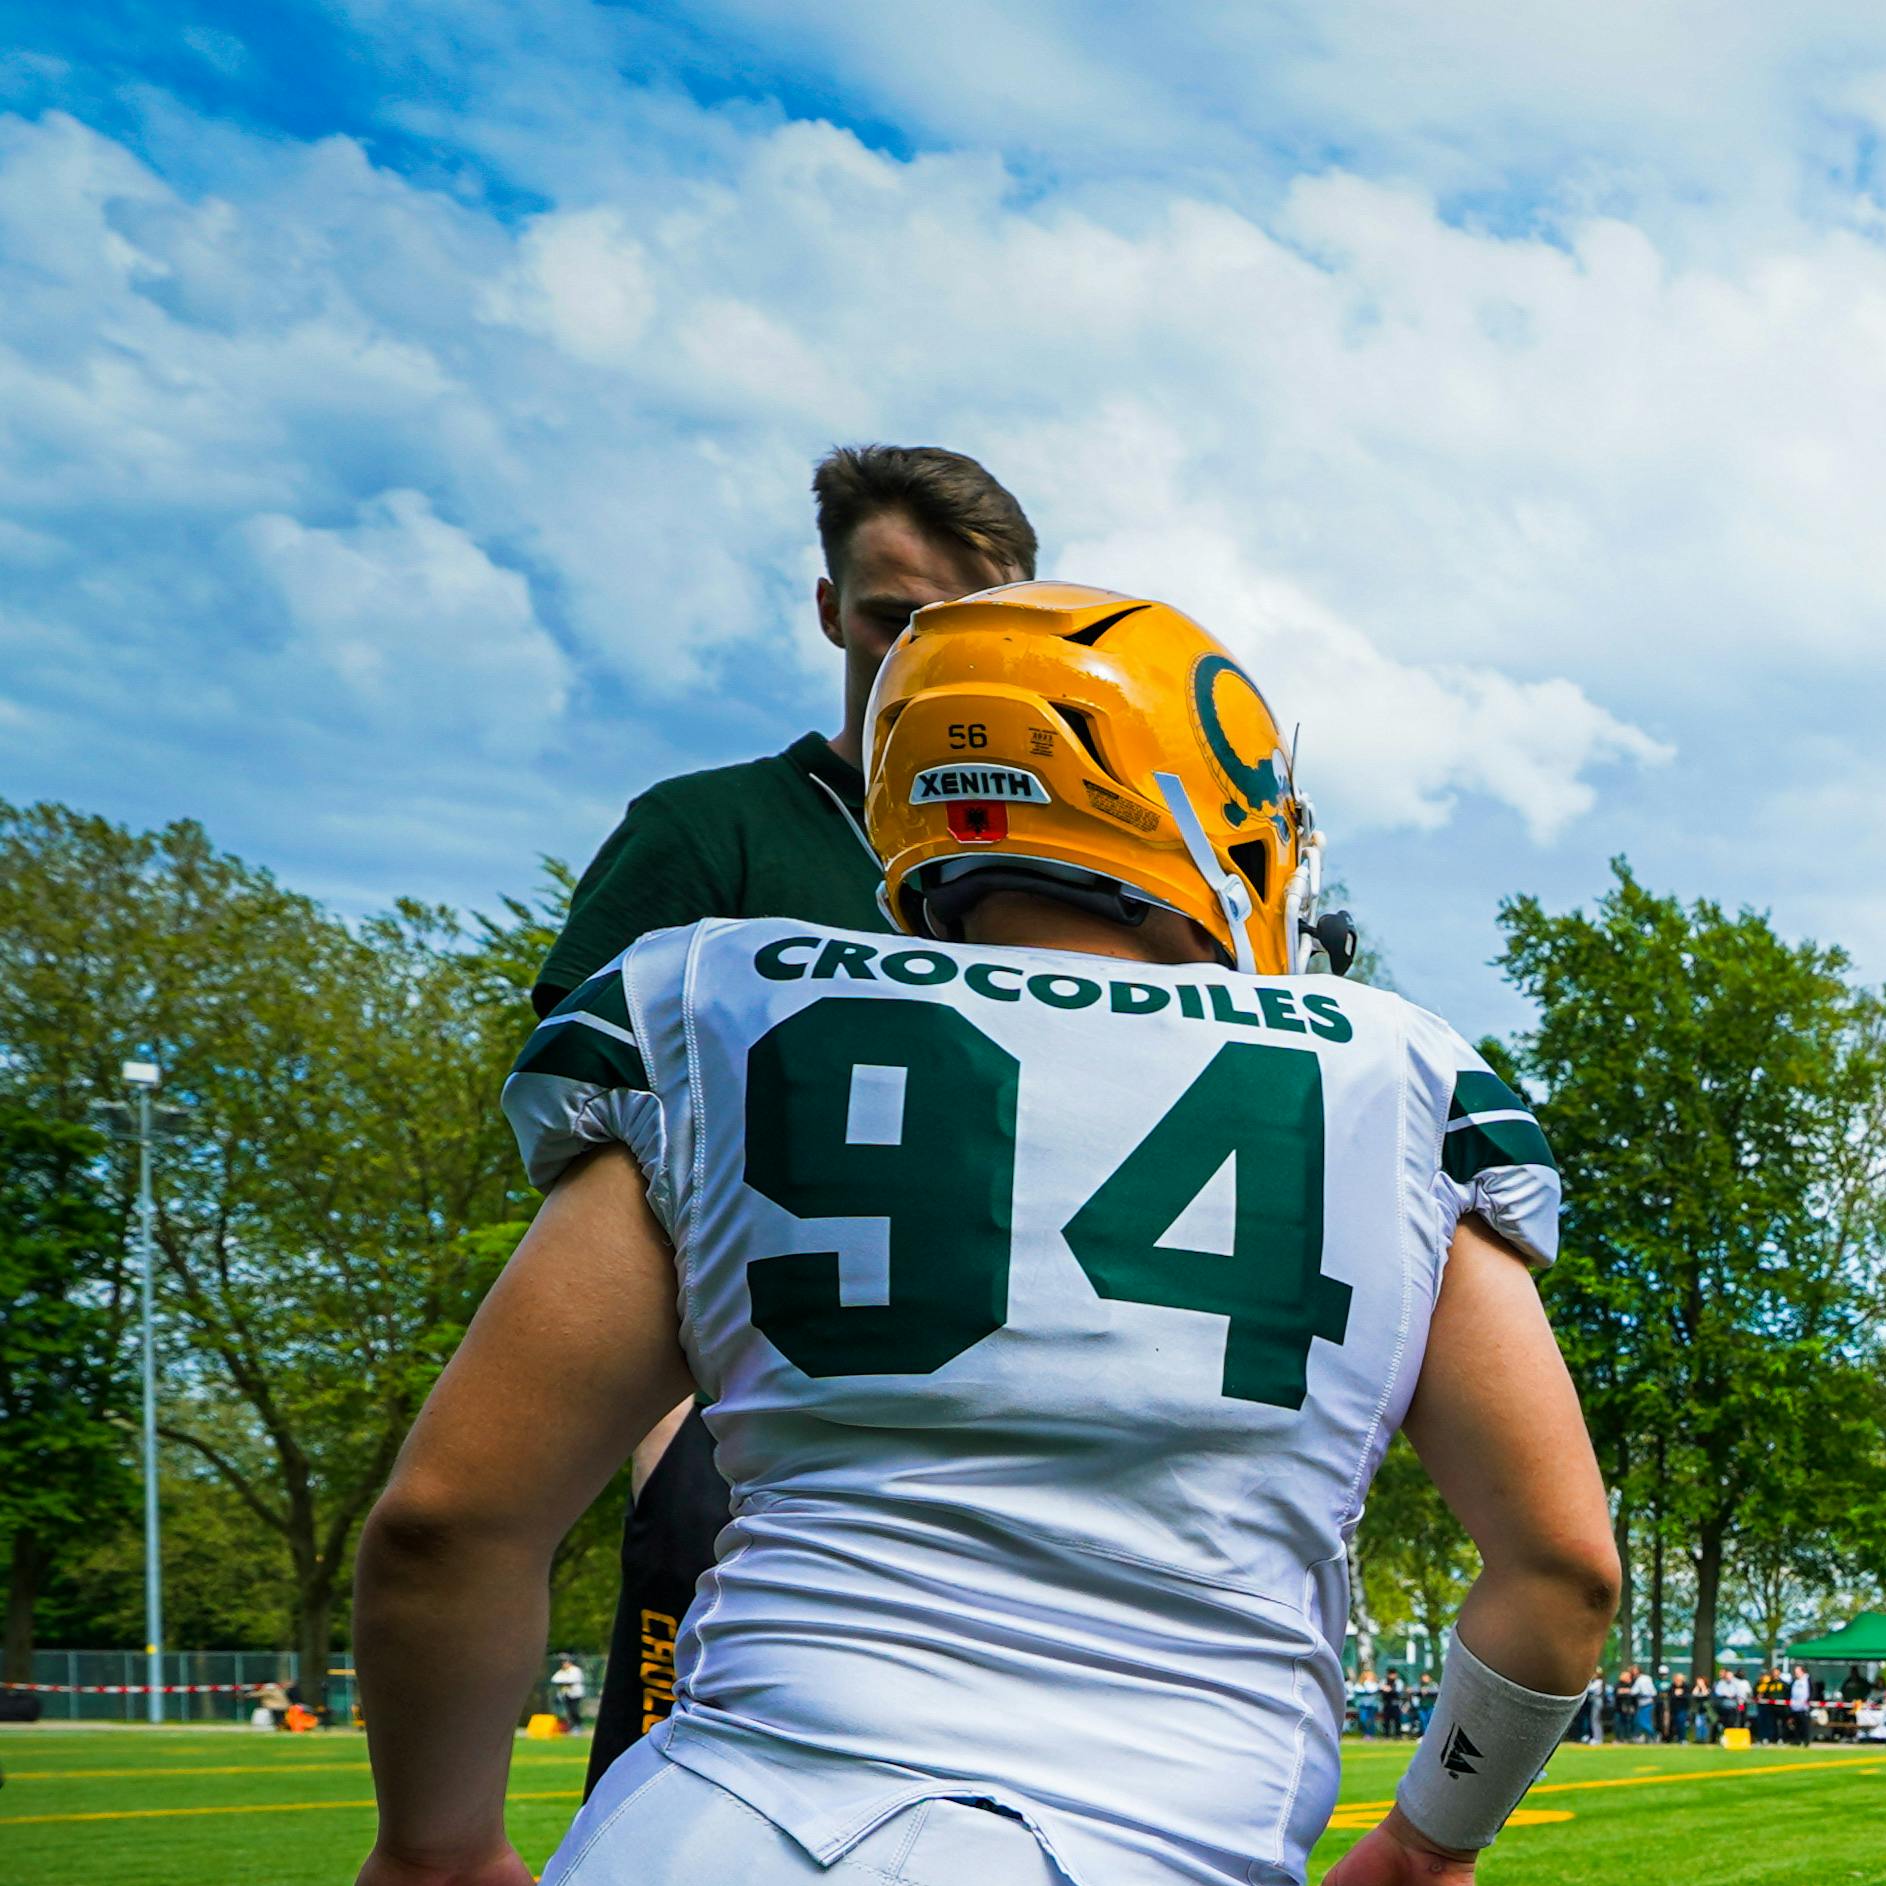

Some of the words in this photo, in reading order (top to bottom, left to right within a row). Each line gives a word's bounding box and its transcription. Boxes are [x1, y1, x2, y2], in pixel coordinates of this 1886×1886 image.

[948, 723, 988, 750] 56
[919, 771, 1032, 798] XENITH
[754, 936, 1354, 1045] CROCODILES
[743, 997, 1354, 1412] 94
